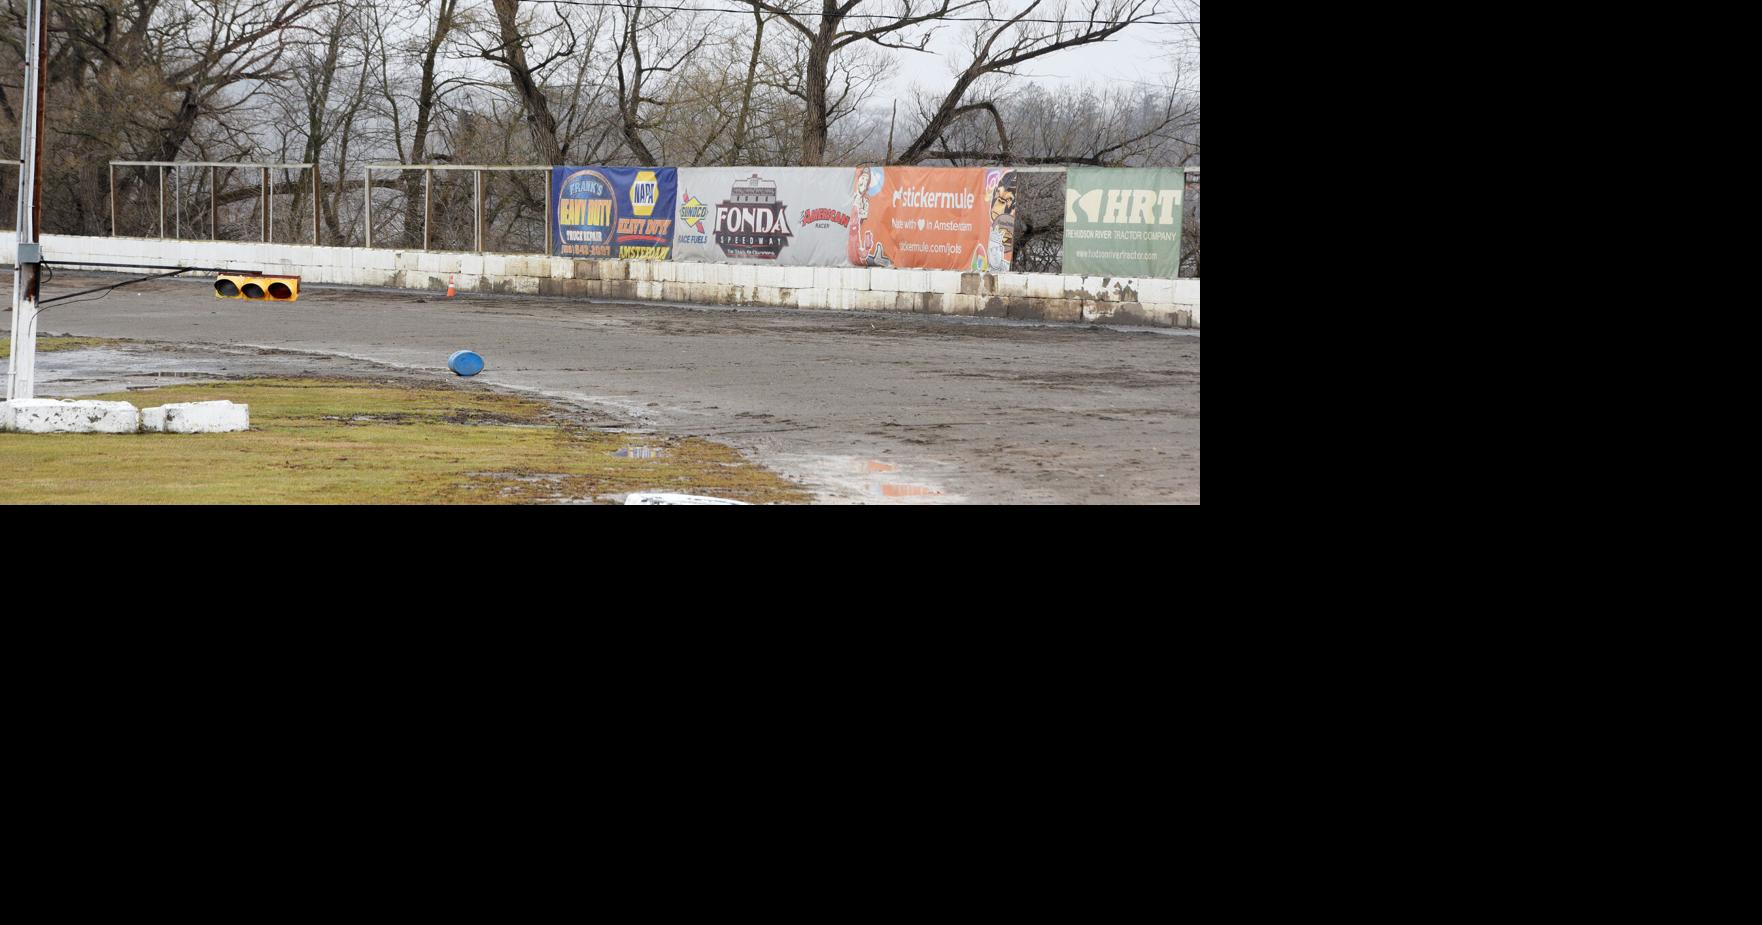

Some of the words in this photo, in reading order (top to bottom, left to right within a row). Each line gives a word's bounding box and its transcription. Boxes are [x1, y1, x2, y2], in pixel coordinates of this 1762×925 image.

[569, 180, 604, 196] FRANK'S
[634, 183, 655, 204] NAPA
[903, 186, 975, 209] stickermule
[560, 199, 587, 226] HEAVY
[588, 199, 612, 227] DUTY
[680, 206, 708, 218] SUNOCO
[1103, 189, 1183, 225] HRT
[715, 206, 791, 235] FONDA
[802, 208, 850, 228] AMERICAN
[926, 221, 933, 231] in
[617, 218, 647, 235] HEAVY
[646, 219, 672, 236] DUTY
[1073, 229, 1094, 239] HUDSON
[1094, 230, 1112, 240] RIVER
[1114, 230, 1142, 240] TRACTOR
[1142, 231, 1177, 241] COMPANY
[566, 230, 583, 241] TRUCK
[691, 235, 708, 245] FUELS
[720, 235, 781, 246] SPEEDWAY
[618, 246, 670, 261] AMSTERDAM
